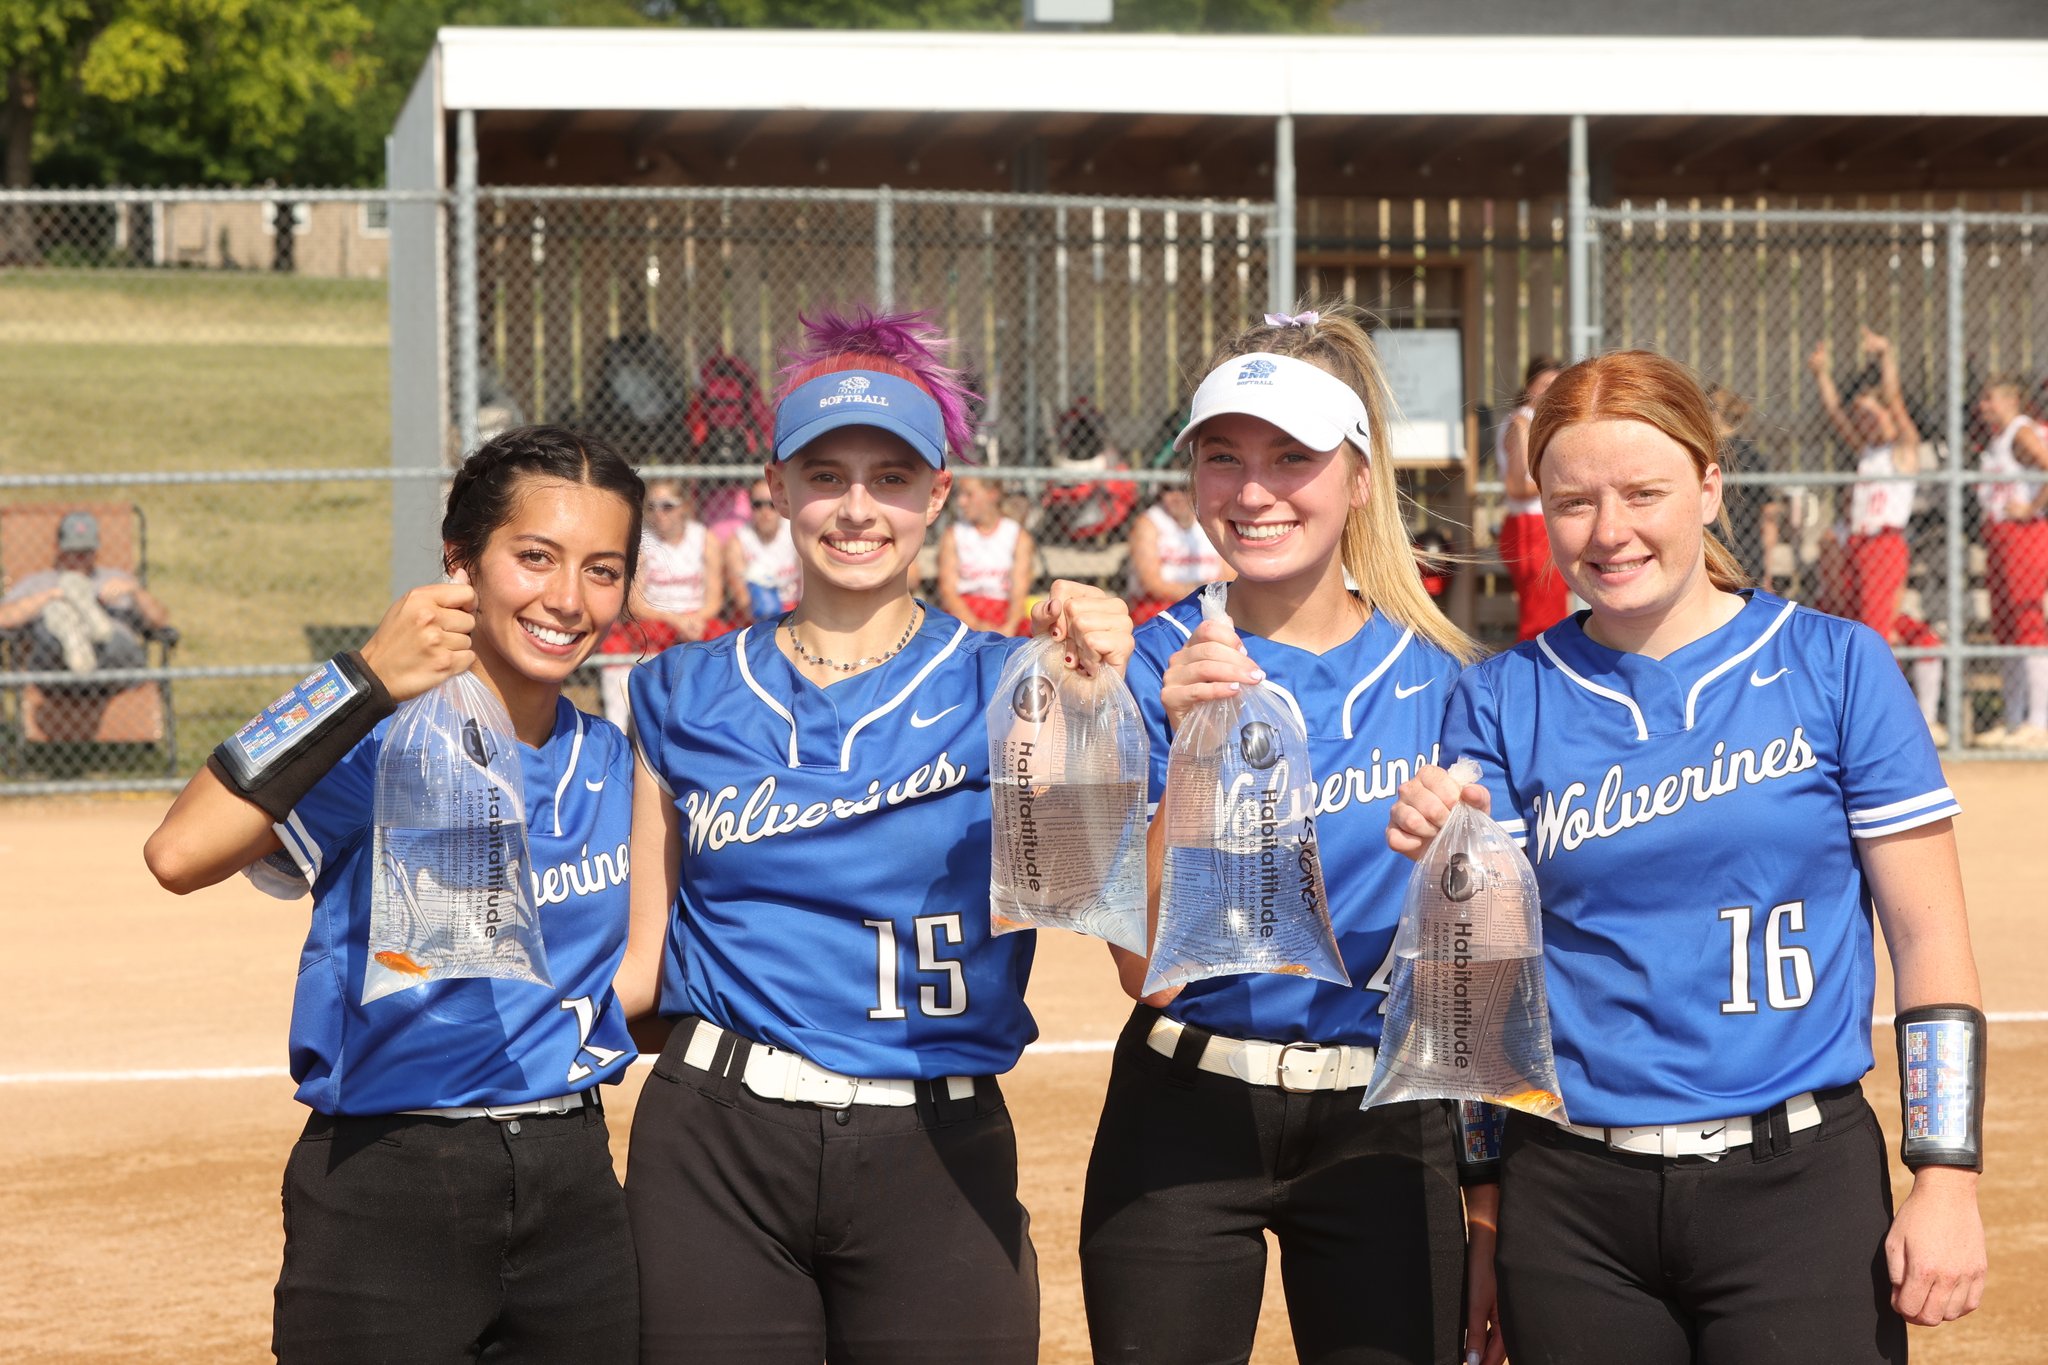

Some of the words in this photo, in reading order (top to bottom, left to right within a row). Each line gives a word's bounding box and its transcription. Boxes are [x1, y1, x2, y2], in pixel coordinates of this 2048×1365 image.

[819, 394, 889, 408] SOFTBALL
[1009, 741, 1017, 787] PROTECT
[1533, 726, 1818, 865] Wolverines
[466, 804, 474, 818] NOT
[686, 751, 968, 857] Wolverines
[1017, 742, 1042, 893] Habitattitude
[1237, 821, 1245, 848] RELEASE
[1248, 791, 1256, 837] PROTECT
[485, 787, 504, 939] Habitattitude
[1237, 866, 1245, 881] AND
[1260, 789, 1279, 938] Habitattitude
[1248, 865, 1256, 938] ENVIRONMENT
[1433, 922, 1440, 933] DO
[862, 911, 968, 1021] 15
[1432, 950, 1440, 977] RELEASE
[1718, 899, 1816, 1015] 16
[1442, 994, 1450, 1066] ENVIRONMENT
[1454, 922, 1473, 1069] Habitattitude
